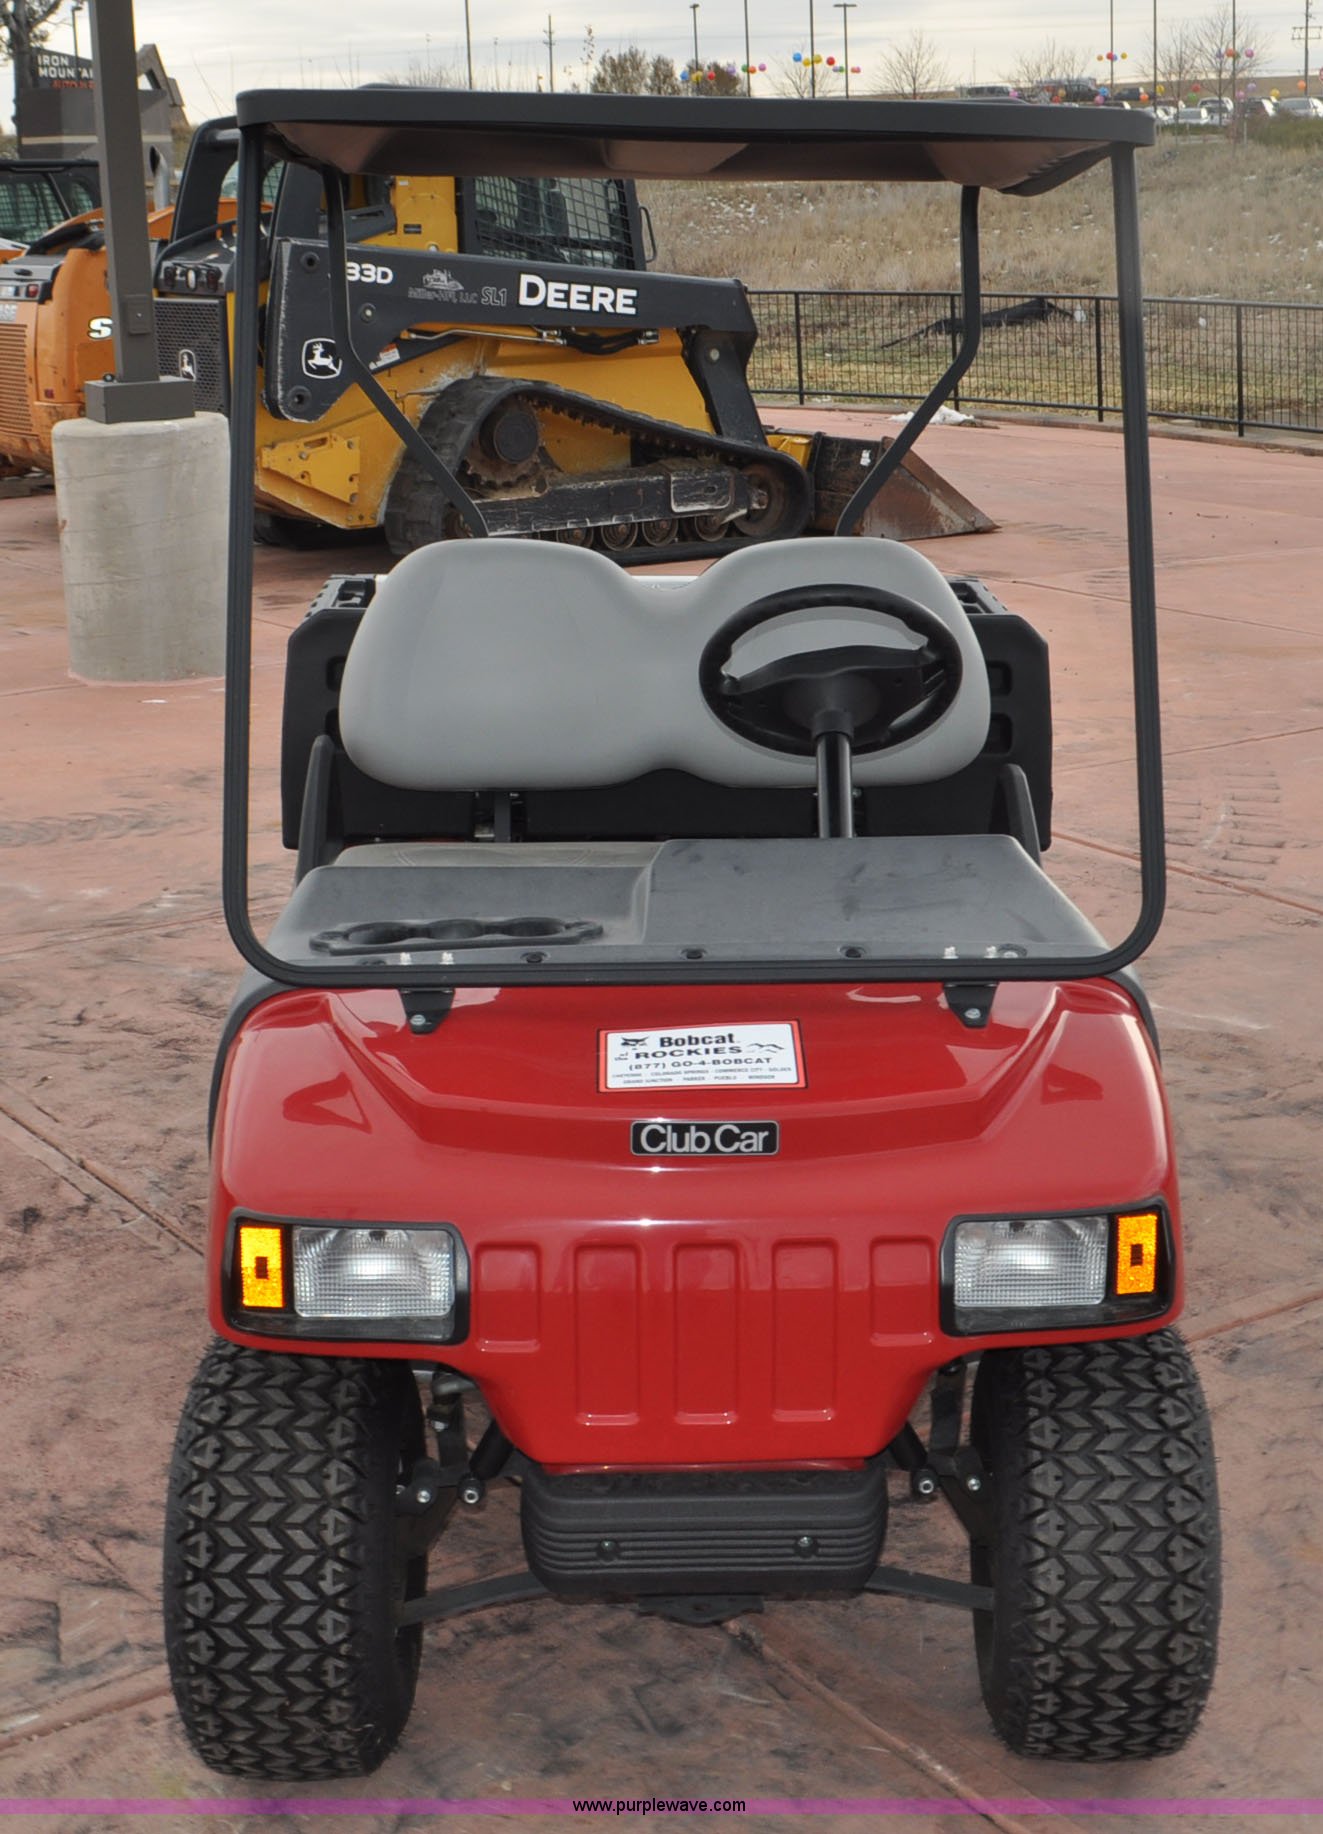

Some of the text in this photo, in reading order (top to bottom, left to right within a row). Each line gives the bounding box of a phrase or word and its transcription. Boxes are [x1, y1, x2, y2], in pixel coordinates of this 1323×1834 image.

[37, 55, 69, 66] IRON
[328, 261, 393, 284] 33D
[519, 273, 637, 315] DEERE
[659, 1033, 735, 1047] Bobcat
[635, 1046, 742, 1059] ROCKIES
[629, 1057, 772, 1071] (877) GO-4-BOBCAT
[640, 1124, 769, 1152] Club Car
